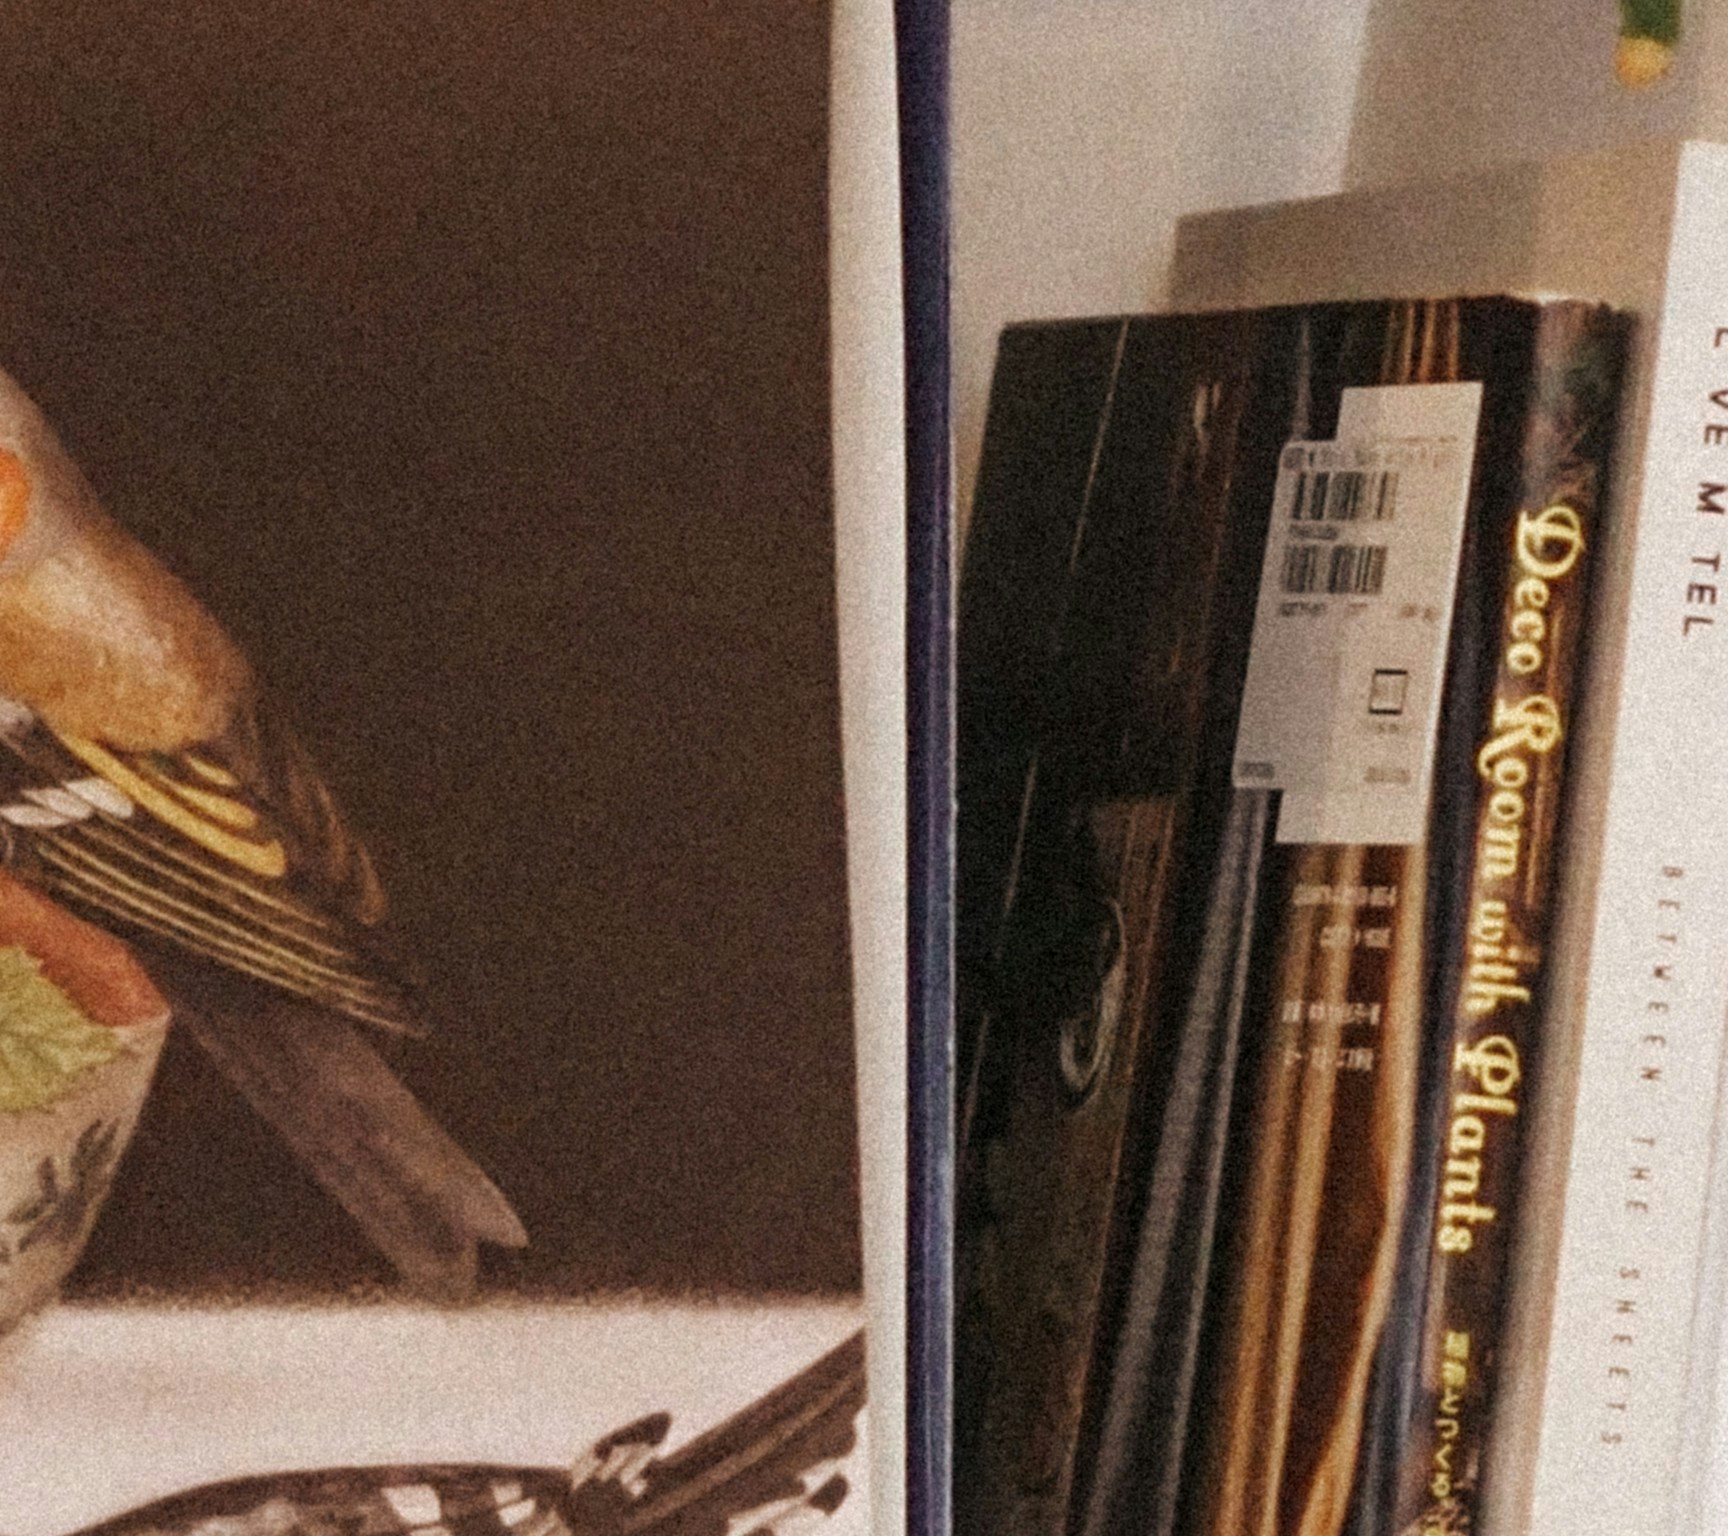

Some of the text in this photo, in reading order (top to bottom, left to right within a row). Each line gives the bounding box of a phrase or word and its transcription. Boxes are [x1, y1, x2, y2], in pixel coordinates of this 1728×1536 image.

[1437, 504, 1586, 1254] Deco Room with Plants
[1600, 865, 1683, 1446] BETWEEN THE SHEETS
